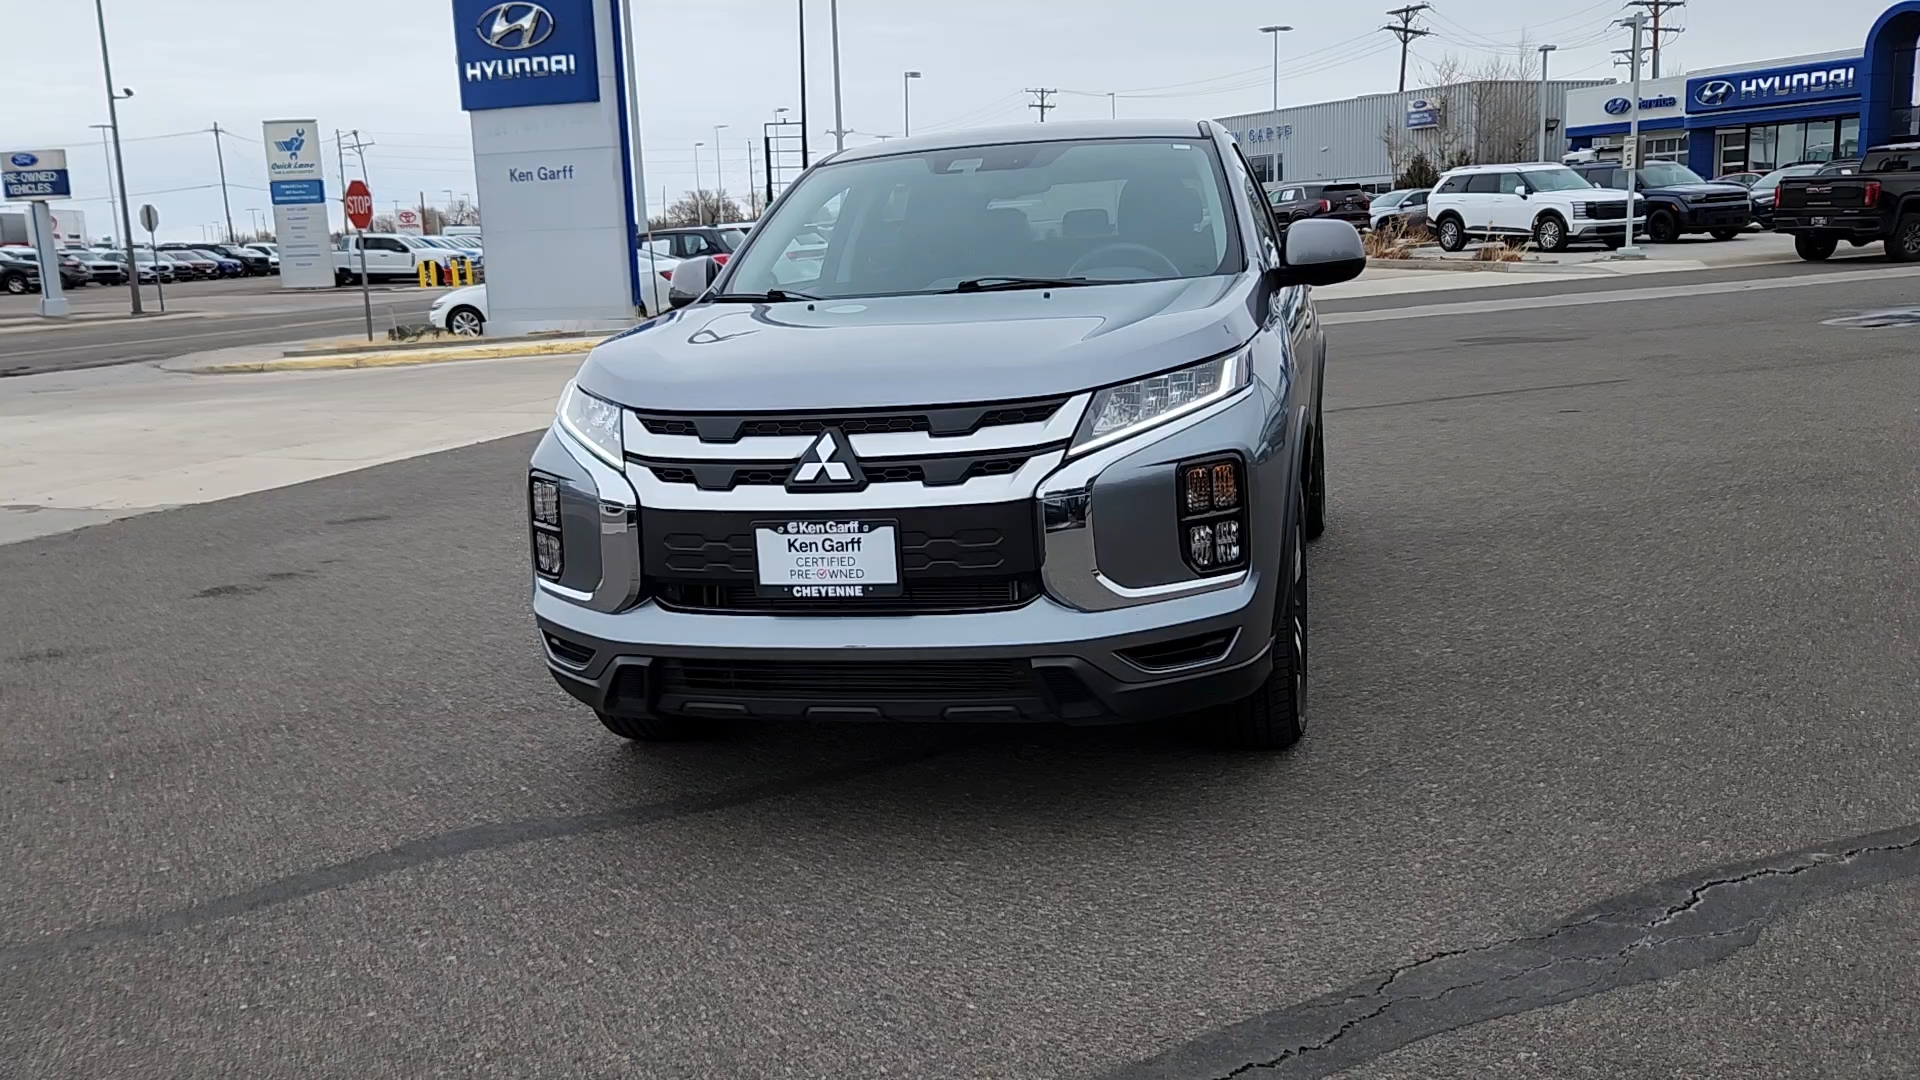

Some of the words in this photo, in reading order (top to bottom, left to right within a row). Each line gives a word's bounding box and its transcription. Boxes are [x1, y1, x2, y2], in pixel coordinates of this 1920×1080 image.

[466, 54, 576, 82] HYUNDAI
[1741, 67, 1855, 99] HYUNDAI
[271, 162, 292, 170] Quick
[294, 161, 315, 169] Lane
[1626, 154, 1632, 166] 5
[509, 167, 533, 182] Ken
[537, 165, 575, 181] Garff
[8, 183, 53, 195] VEHICLES
[347, 195, 371, 215] STOP
[799, 521, 825, 533] Ken
[826, 521, 860, 533] Garff
[787, 538, 818, 552] Ken
[822, 537, 862, 552] Garff
[796, 556, 856, 567] CERTIFIED
[792, 586, 864, 597] CHEYENNE
